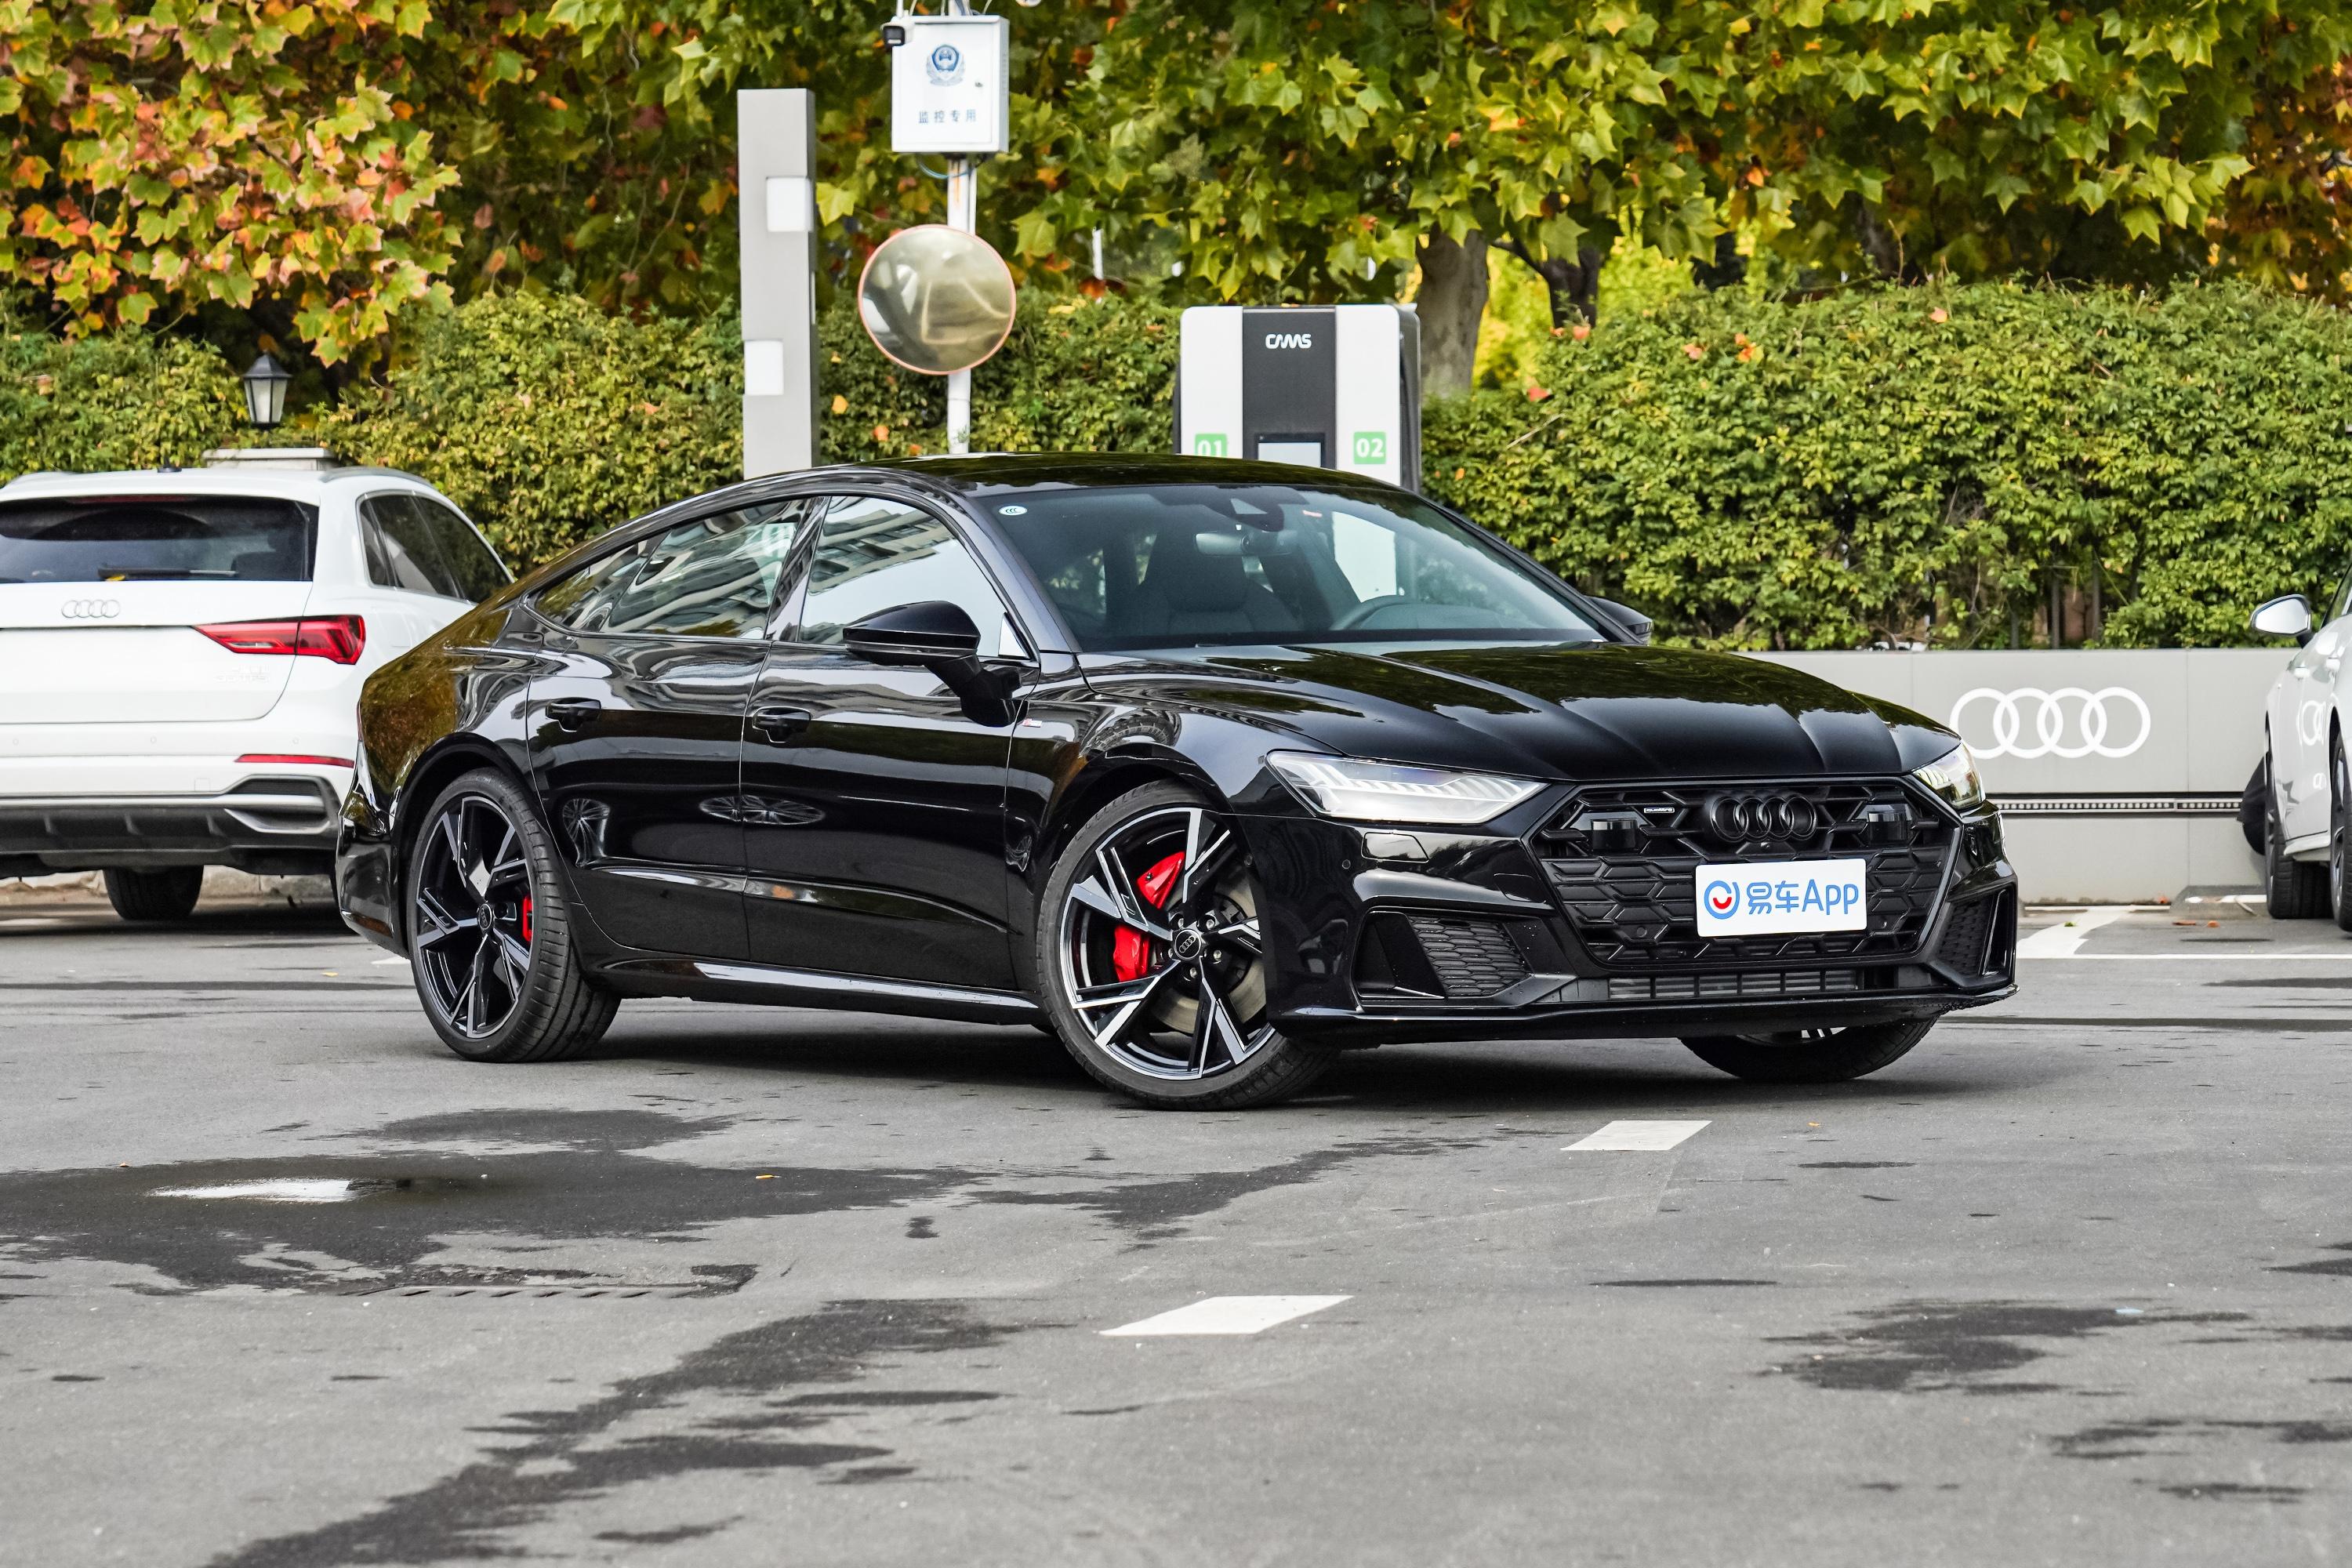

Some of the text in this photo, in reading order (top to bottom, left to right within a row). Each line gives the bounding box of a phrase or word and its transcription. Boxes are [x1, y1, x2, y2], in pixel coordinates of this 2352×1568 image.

[919, 109, 976, 123] 监控专用
[1198, 439, 1222, 457] 01
[1356, 437, 1384, 458] 02
